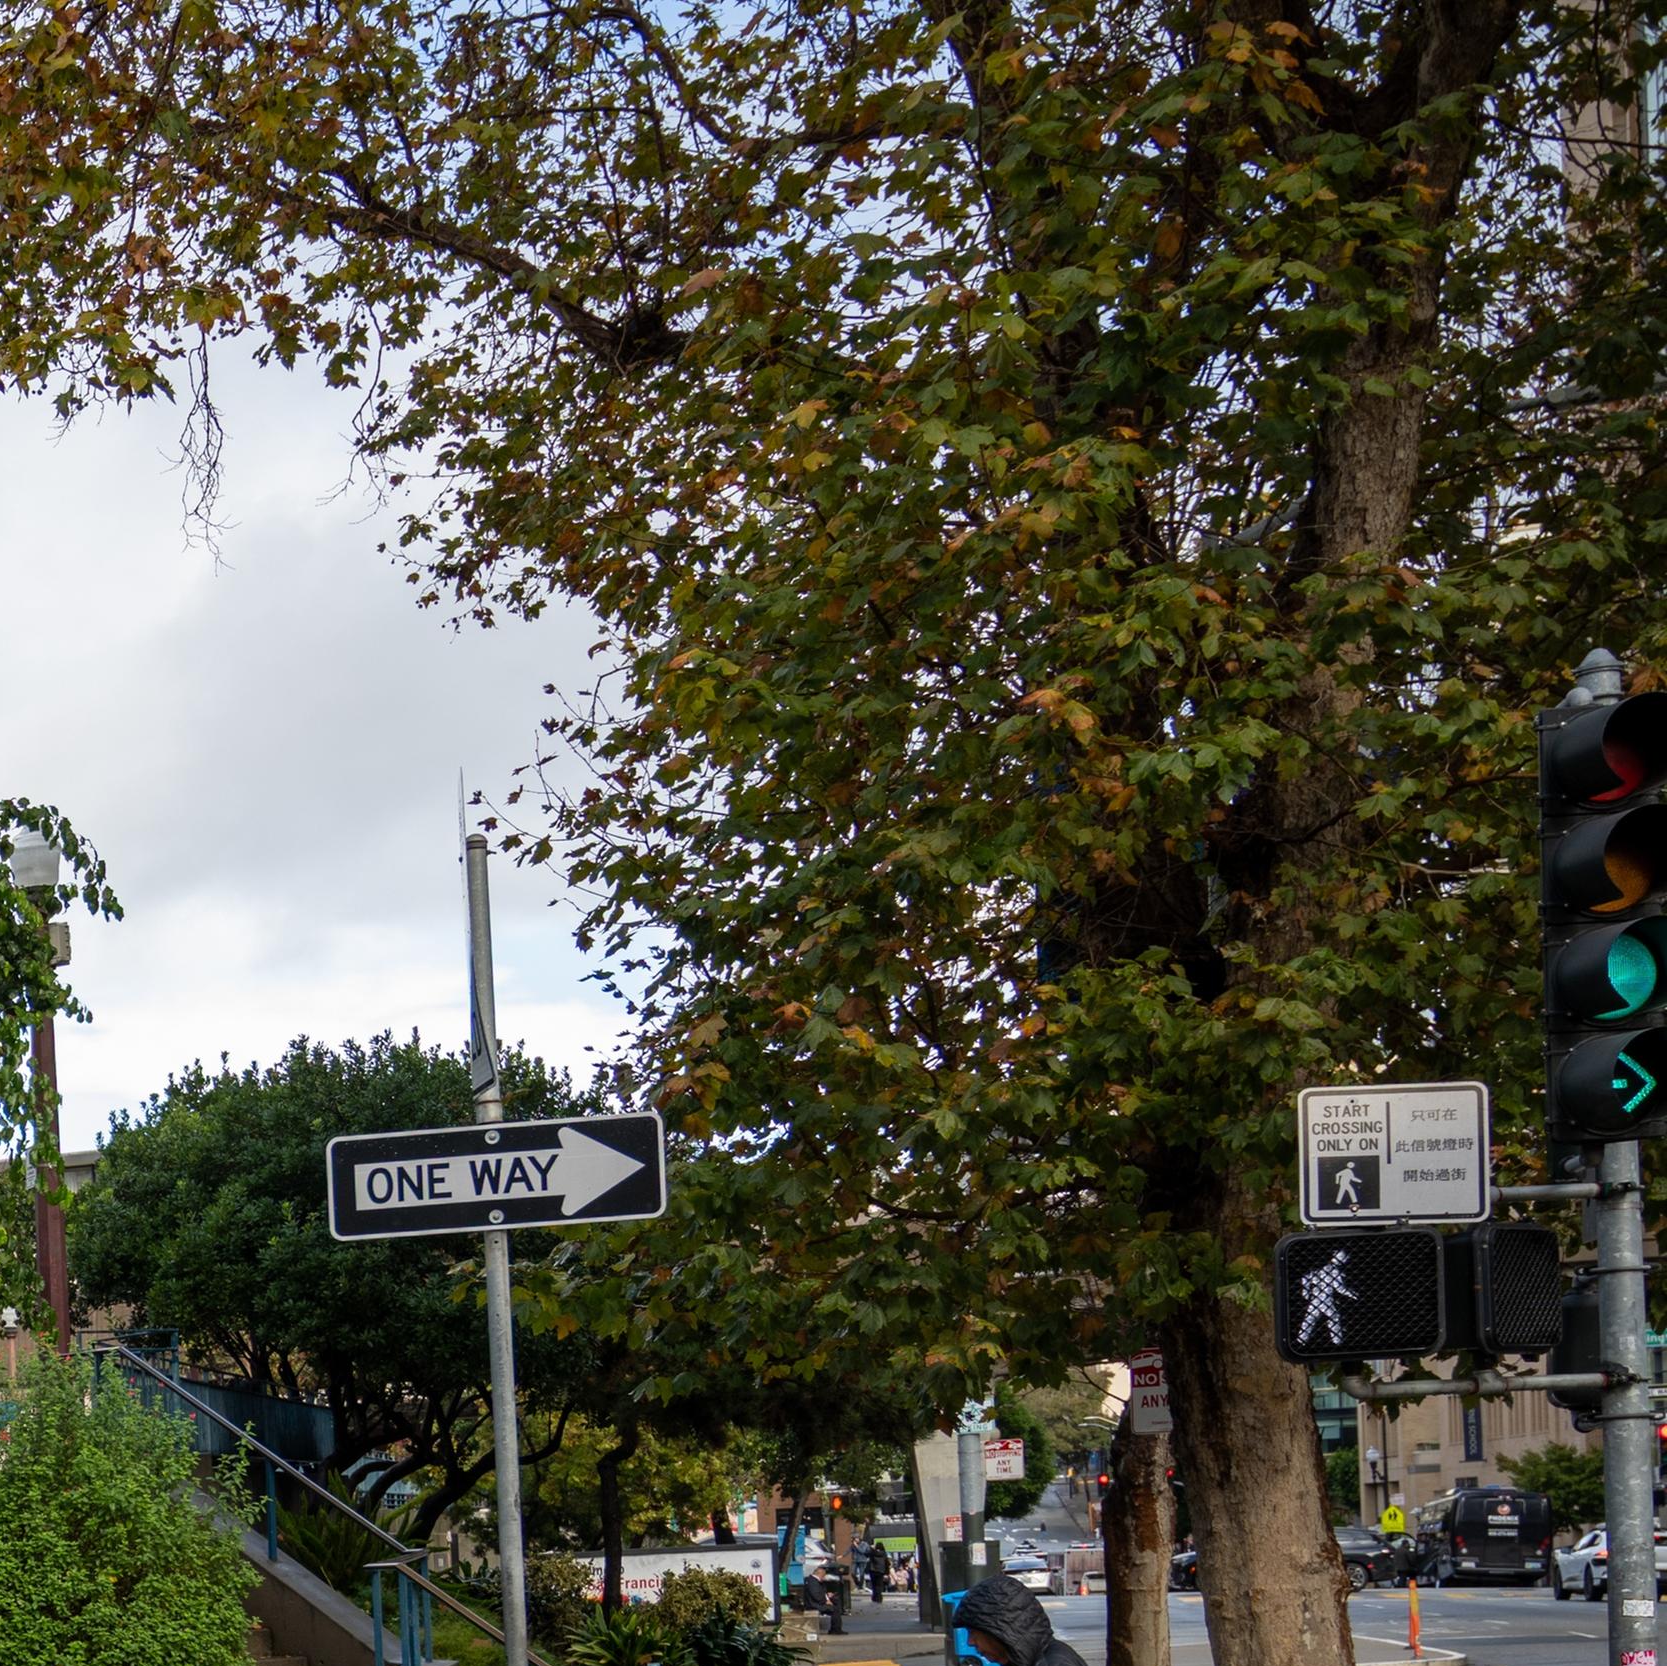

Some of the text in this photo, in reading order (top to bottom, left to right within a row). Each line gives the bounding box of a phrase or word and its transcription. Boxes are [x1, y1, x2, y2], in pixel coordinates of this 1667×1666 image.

[1323, 1104, 1371, 1118] START
[1410, 1108, 1458, 1122] 只可在
[1312, 1121, 1383, 1135] CROSSING
[1317, 1138, 1378, 1152] ONLY ON
[367, 1154, 559, 1204] ONE WAY
[1403, 1168, 1466, 1183] 開始過街
[1134, 1373, 1157, 1386] NO
[1141, 1394, 1169, 1408] ANY
